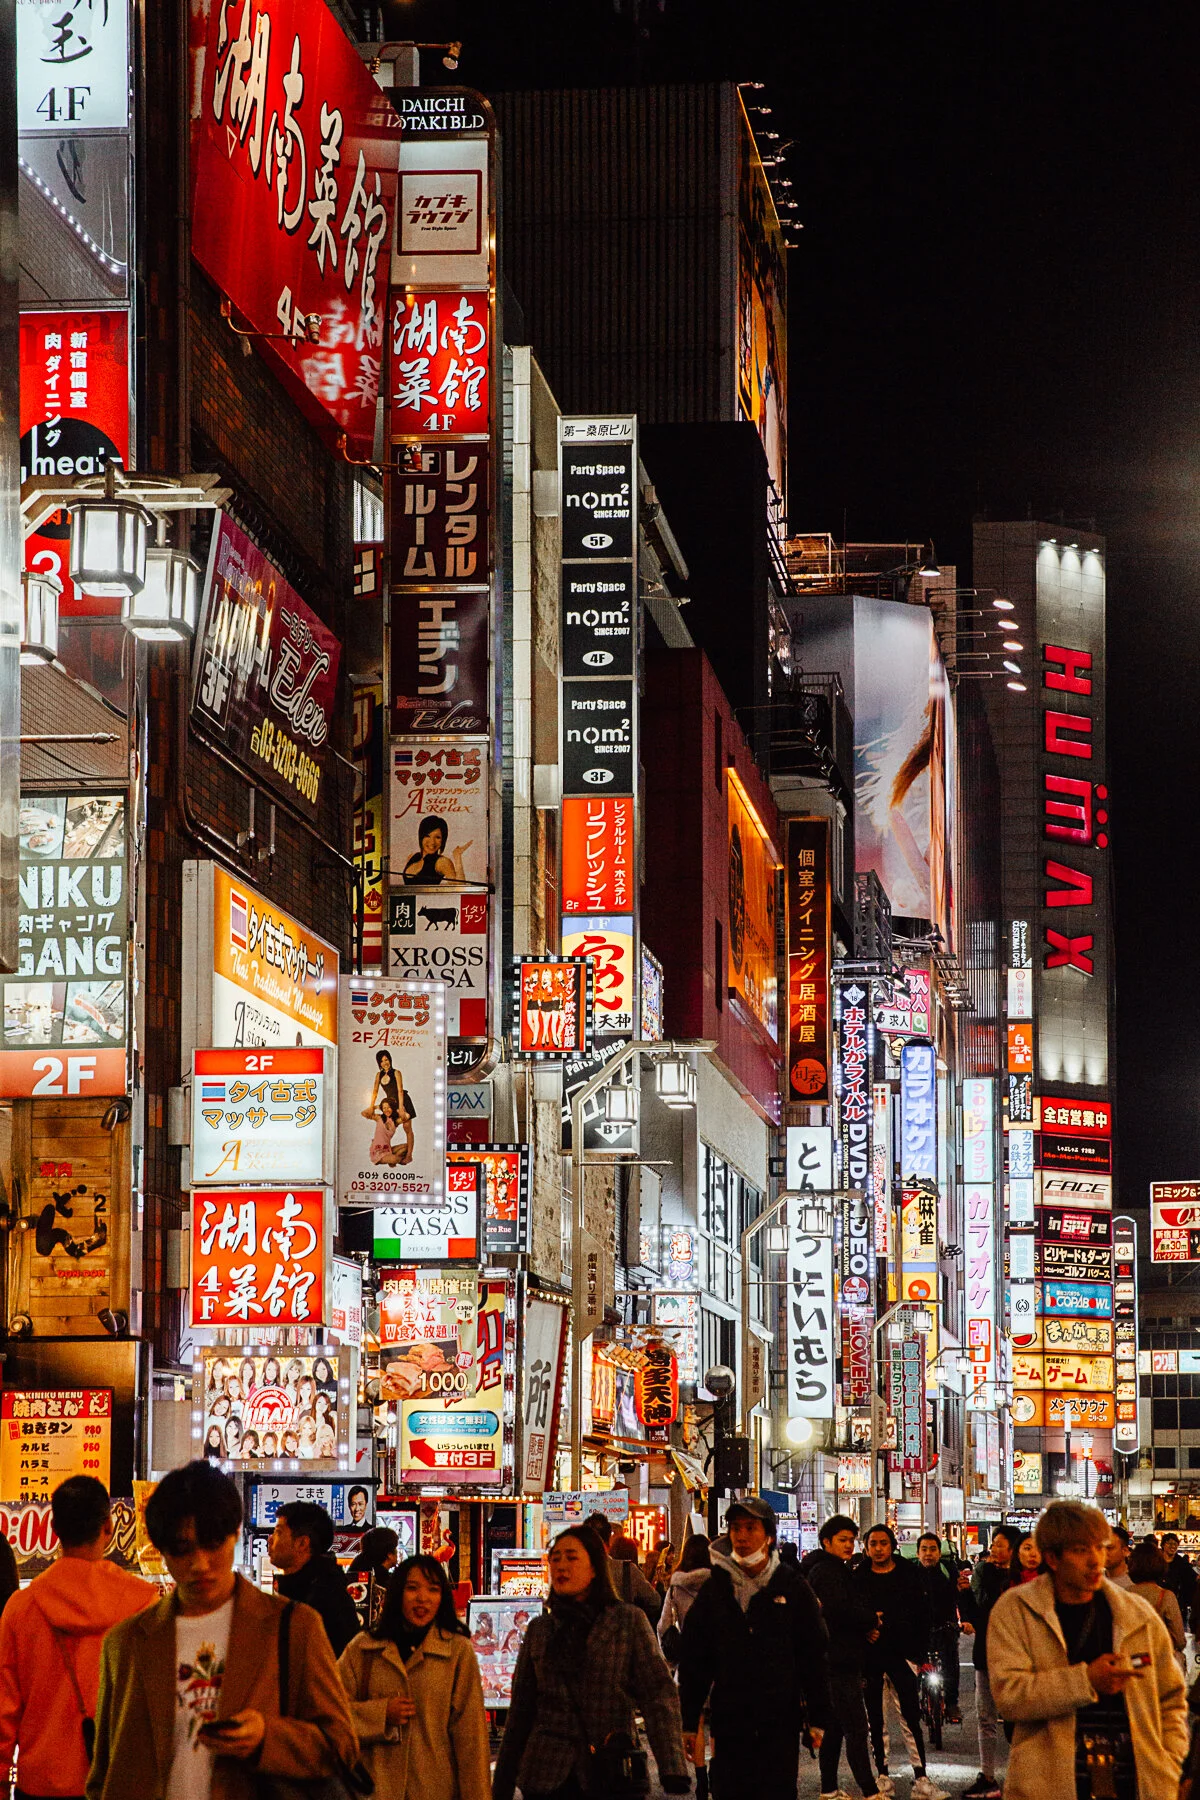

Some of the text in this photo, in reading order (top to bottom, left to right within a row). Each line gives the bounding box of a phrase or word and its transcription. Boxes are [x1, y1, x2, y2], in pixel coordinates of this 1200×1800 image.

[36, 86, 91, 121] 4F
[402, 98, 465, 112] DAIICHI
[450, 115, 485, 129] BLD
[415, 194, 467, 208] カブキ
[406, 209, 474, 225] ラウンジ
[69, 332, 88, 408] 新宿個室
[44, 332, 62, 447] 肉ダイニング
[422, 413, 457, 431] 4F
[563, 424, 631, 437] 第一桑原ビル
[570, 464, 625, 475] Party Space
[445, 451, 478, 577] レンタル
[593, 509, 630, 518] SINCE 2007
[403, 484, 437, 577] ルーム
[590, 536, 606, 547] 5F
[570, 582, 626, 593] Party Space
[593, 627, 630, 636] SINCE 2007
[417, 601, 456, 695] エデン
[590, 654, 606, 664] 4F
[202, 661, 229, 715] 3F
[269, 637, 331, 748] Eden
[571, 700, 626, 710] Party Space
[410, 699, 481, 730] Eden
[594, 744, 630, 753] SINCE 2007
[258, 717, 321, 805] 03-3203-9666
[415, 749, 482, 767] タイ古式
[394, 768, 482, 787] マッサージ
[590, 771, 606, 782] 3F
[586, 802, 607, 910] リフレッシュ
[614, 801, 627, 905] レンタルルーム ホステル
[394, 902, 411, 919] 肉
[461, 904, 486, 915] イタリ
[566, 900, 580, 910] 2F
[392, 919, 414, 929] バル
[465, 914, 483, 924] アン
[587, 918, 610, 930] 1F
[249, 905, 325, 996] タイ古式マッサージ
[798, 849, 816, 1043] 個室ダイニング居酒屋
[391, 946, 485, 968] XROSS
[370, 991, 430, 1010] タイ古式
[351, 1009, 431, 1027] マッサージ
[352, 1031, 374, 1044] 2F
[593, 1038, 626, 1065] Space
[245, 1055, 274, 1071] 2F
[842, 1006, 866, 1121] ホテルがライバル
[32, 1056, 97, 1096] 2F
[229, 1078, 317, 1103] タイ古式
[905, 1046, 933, 1152] カラオケ
[202, 1104, 317, 1130] マッサージ
[1044, 1107, 1108, 1129] 全店営業中
[603, 1125, 621, 1135] B1
[1010, 1143, 1021, 1172] の鉄人
[1022, 1131, 1033, 1172] カラオケ
[358, 1171, 379, 1181] 60分
[450, 1171, 475, 1181] イタリ
[351, 1181, 430, 1194] 03-3207-5527
[452, 1181, 472, 1191] アン
[1045, 1179, 1109, 1194] FACE
[902, 1192, 914, 1201] 3F
[391, 1216, 461, 1236] CASA
[918, 1194, 934, 1246] 麻雀
[968, 1191, 991, 1310] カラオケ
[1044, 1246, 1111, 1266] ビリヤード&ダーツ
[1064, 1265, 1111, 1279] ゴルフ バグース
[198, 1265, 223, 1320] 4F
[1046, 1320, 1110, 1343] まんが喫茶
[1154, 1353, 1177, 1371] つり具
[1047, 1365, 1088, 1385] ゲーム
[57, 1391, 83, 1399] MENU
[22, 1422, 73, 1435] ねぎタン
[21, 1443, 50, 1452] カルビ
[20, 1460, 49, 1469] ハラミ
[434, 1452, 493, 1466] 受付3F
[20, 1477, 49, 1486] ロース
[296, 1487, 325, 1499] こまき
